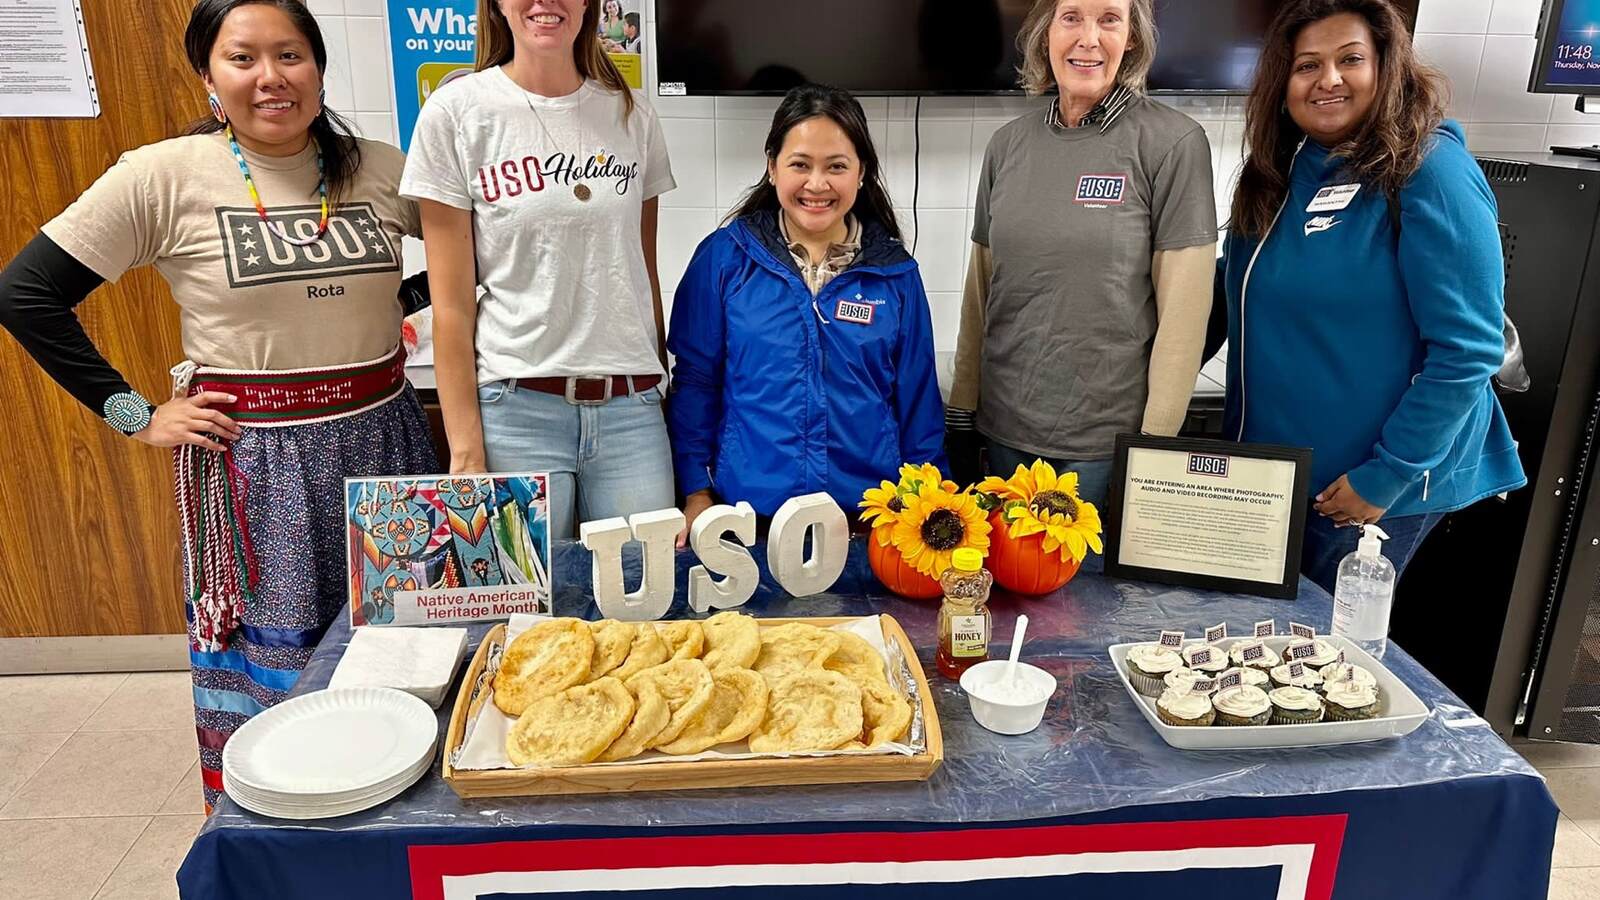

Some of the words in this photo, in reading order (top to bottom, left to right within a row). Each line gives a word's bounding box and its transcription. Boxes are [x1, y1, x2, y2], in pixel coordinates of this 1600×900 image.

[407, 8, 477, 35] Wha
[406, 39, 428, 50] on
[433, 39, 473, 53] your
[1558, 45, 1592, 59] 11:48
[1554, 61, 1585, 70] Thursday,
[478, 156, 545, 202] USO
[539, 152, 638, 195] Holidays
[1086, 179, 1115, 197] USO
[258, 216, 367, 265] USO
[307, 284, 345, 298] Rota
[844, 304, 866, 318] USO
[1197, 457, 1220, 472] USO
[1156, 480, 1185, 488] ENTERING
[1236, 489, 1284, 500] PHOTOGRAPHY,
[1197, 492, 1233, 501] RECORDING
[580, 491, 849, 622] USO
[417, 594, 464, 607] Native
[467, 590, 535, 604] American
[427, 606, 489, 619] Heritage
[493, 601, 538, 614] Month
[955, 633, 981, 641] HONEY
[1165, 634, 1178, 645] USO
[1210, 629, 1222, 640] USO
[1194, 652, 1207, 663] USO
[1246, 647, 1260, 659] USO
[1297, 646, 1311, 657] USO
[1223, 675, 1235, 687] USO
